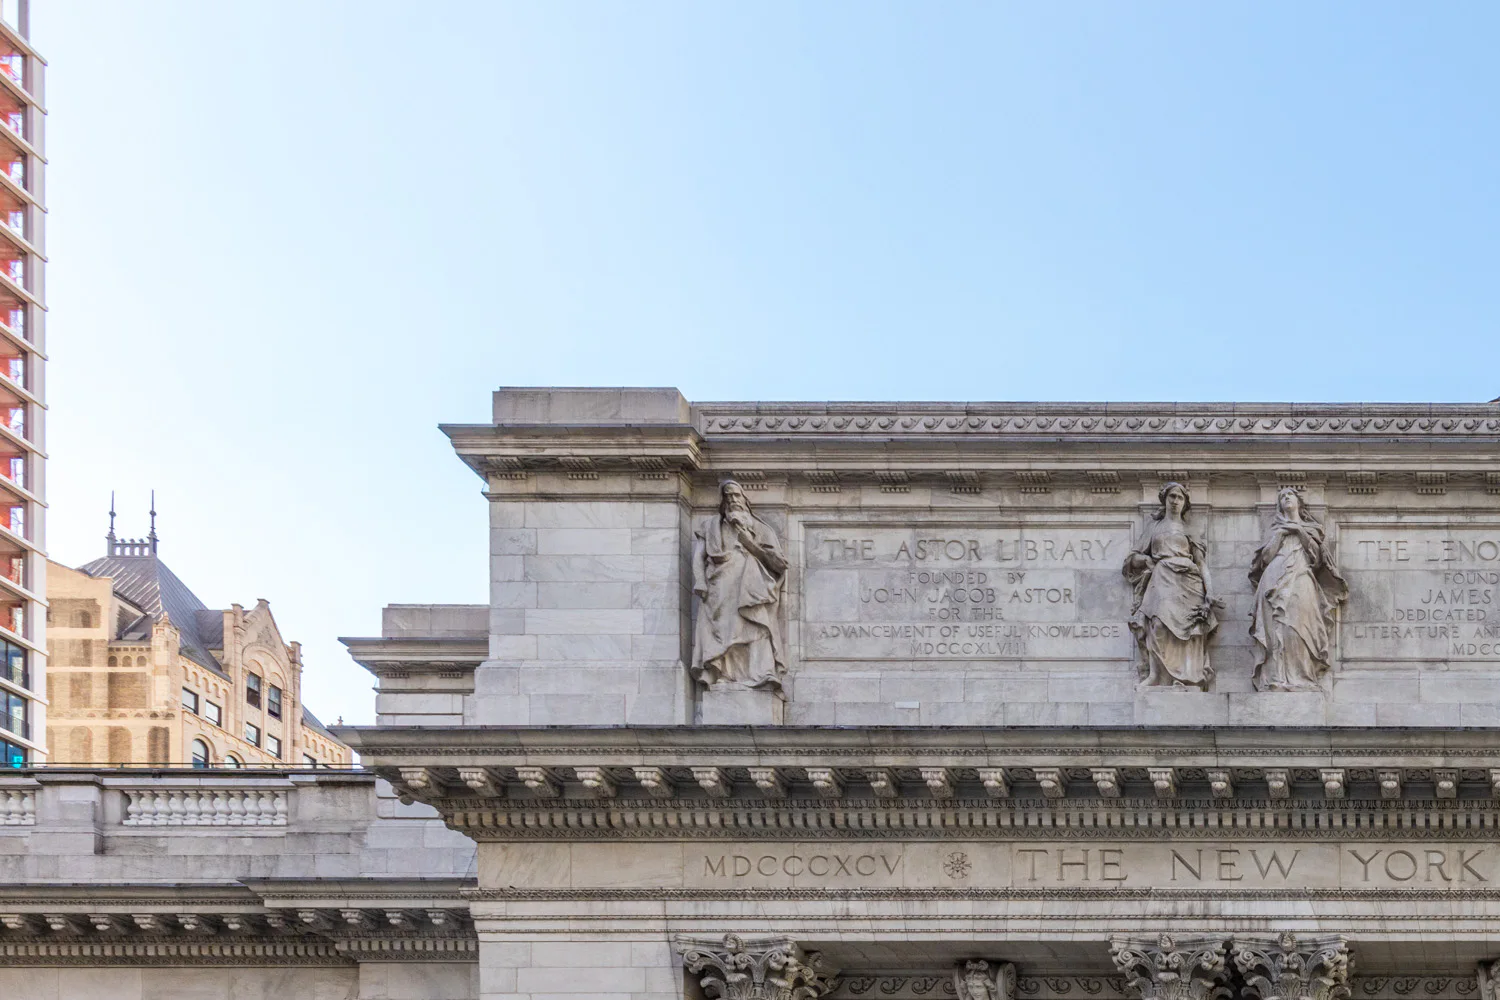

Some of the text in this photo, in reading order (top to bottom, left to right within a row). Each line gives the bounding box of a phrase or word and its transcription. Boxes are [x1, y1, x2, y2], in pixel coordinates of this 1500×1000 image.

[824, 540, 1112, 561] THE ASTOR LIBRARY
[1358, 541, 1409, 562] THE
[909, 572, 1026, 584] FOUNDED BY
[861, 588, 1074, 603] JOHN JACOB ASTOR
[1421, 589, 1491, 605] JAMES
[929, 608, 1004, 620] FOR THE
[1394, 608, 1487, 621] DEDICATED
[819, 626, 1120, 638] ADVANCEMENT OF USEFUL KNOWLEDGE
[1354, 626, 1460, 639] LITERATURE
[703, 854, 902, 877] MDCCCXCV
[1018, 849, 1128, 881] THE
[1169, 849, 1301, 881] NEW
[1351, 849, 1488, 882] YORK
